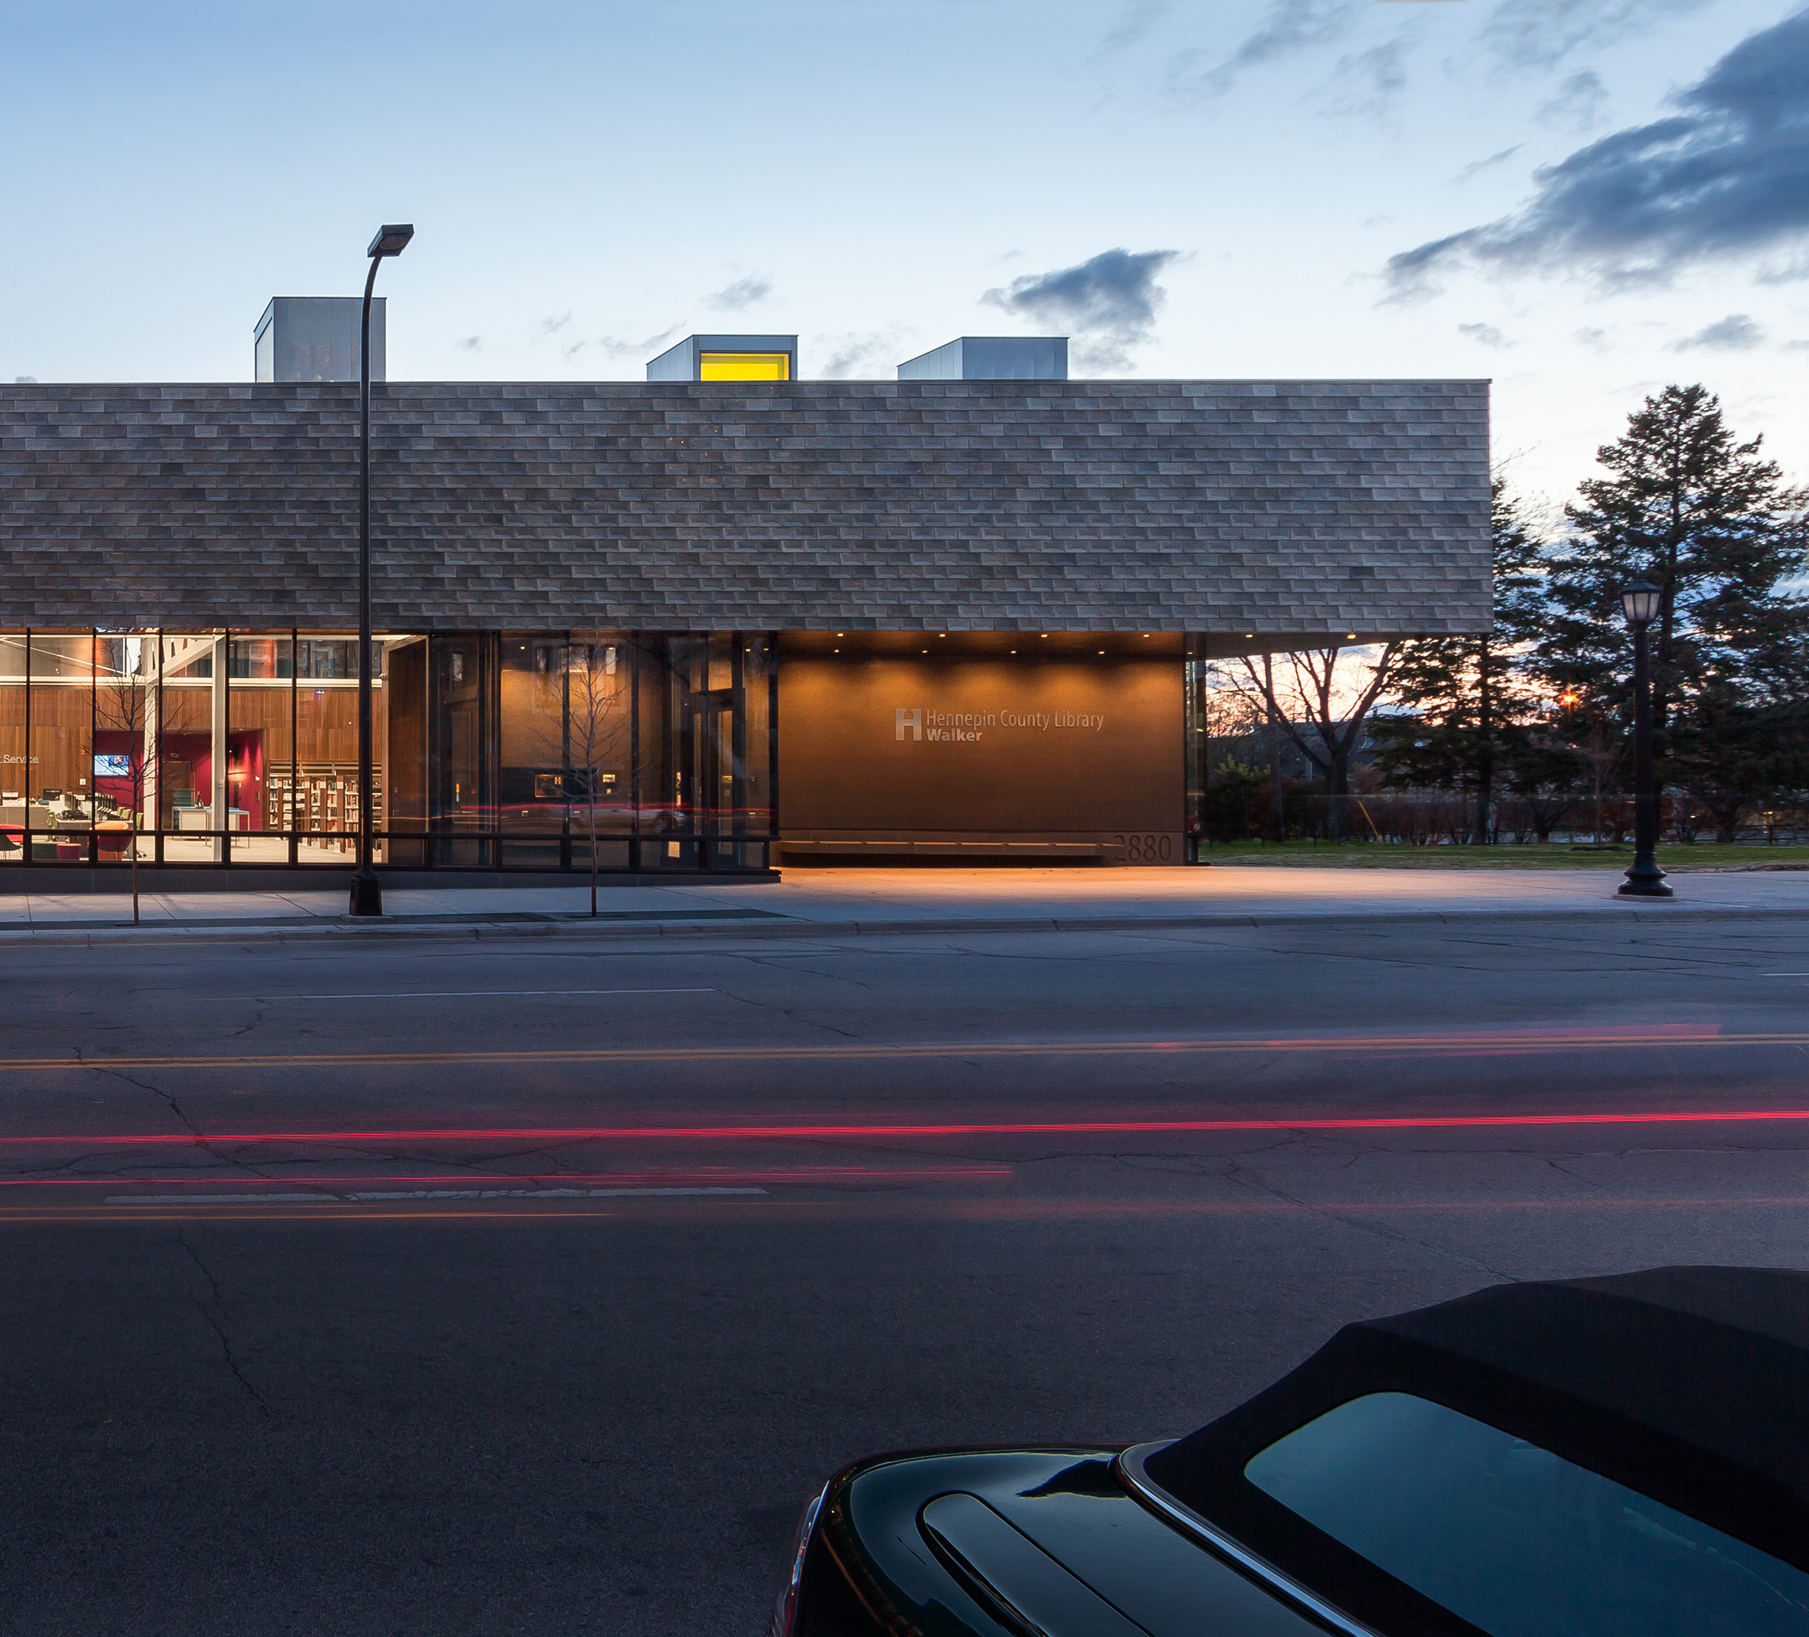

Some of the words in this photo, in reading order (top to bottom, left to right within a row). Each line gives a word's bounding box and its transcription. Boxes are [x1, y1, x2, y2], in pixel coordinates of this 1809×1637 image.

[895, 708, 922, 741] H
[926, 709, 996, 730] Hennepin
[1000, 709, 1051, 731] County
[1054, 710, 1104, 731] Library
[926, 728, 983, 741] Walker
